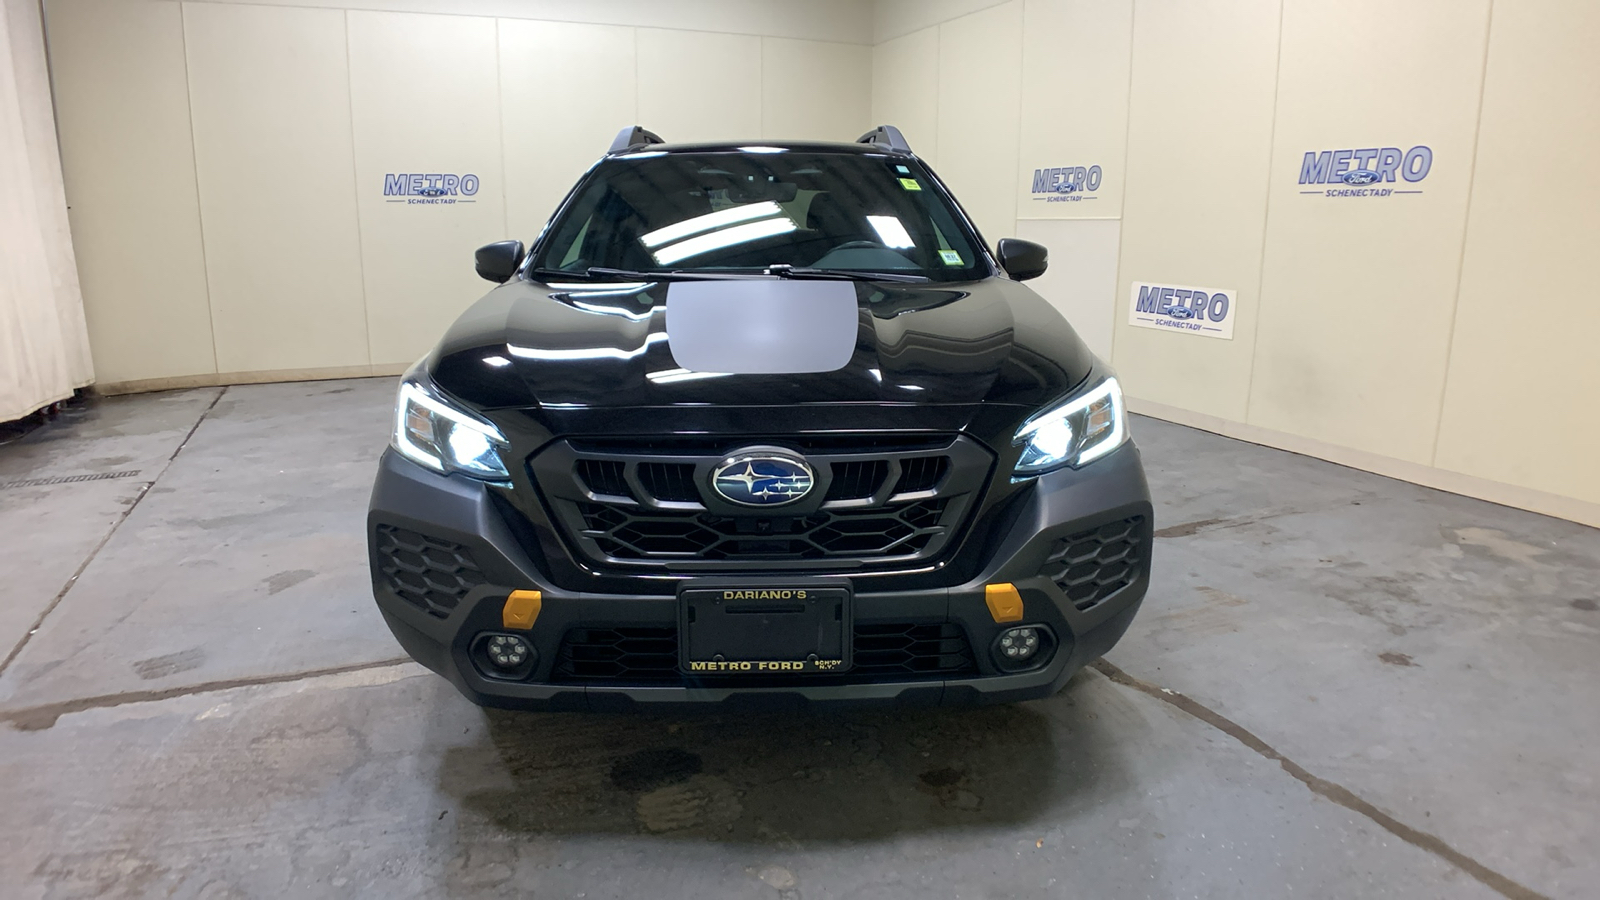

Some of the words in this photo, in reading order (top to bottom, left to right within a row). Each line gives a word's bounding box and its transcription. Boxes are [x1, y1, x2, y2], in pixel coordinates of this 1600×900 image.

[1298, 145, 1433, 185] METRO
[1031, 164, 1103, 194] METRO
[1349, 172, 1374, 184] Ford
[383, 173, 480, 196] METRO
[1046, 195, 1083, 203] SCHENECTADY
[1325, 188, 1394, 198] SCHENECTADY
[1135, 285, 1230, 323] METRO
[1155, 318, 1203, 331] SCHENECTADY
[723, 590, 807, 600] DARIANO'S
[690, 661, 752, 671] METRO
[758, 661, 805, 671] FORD
